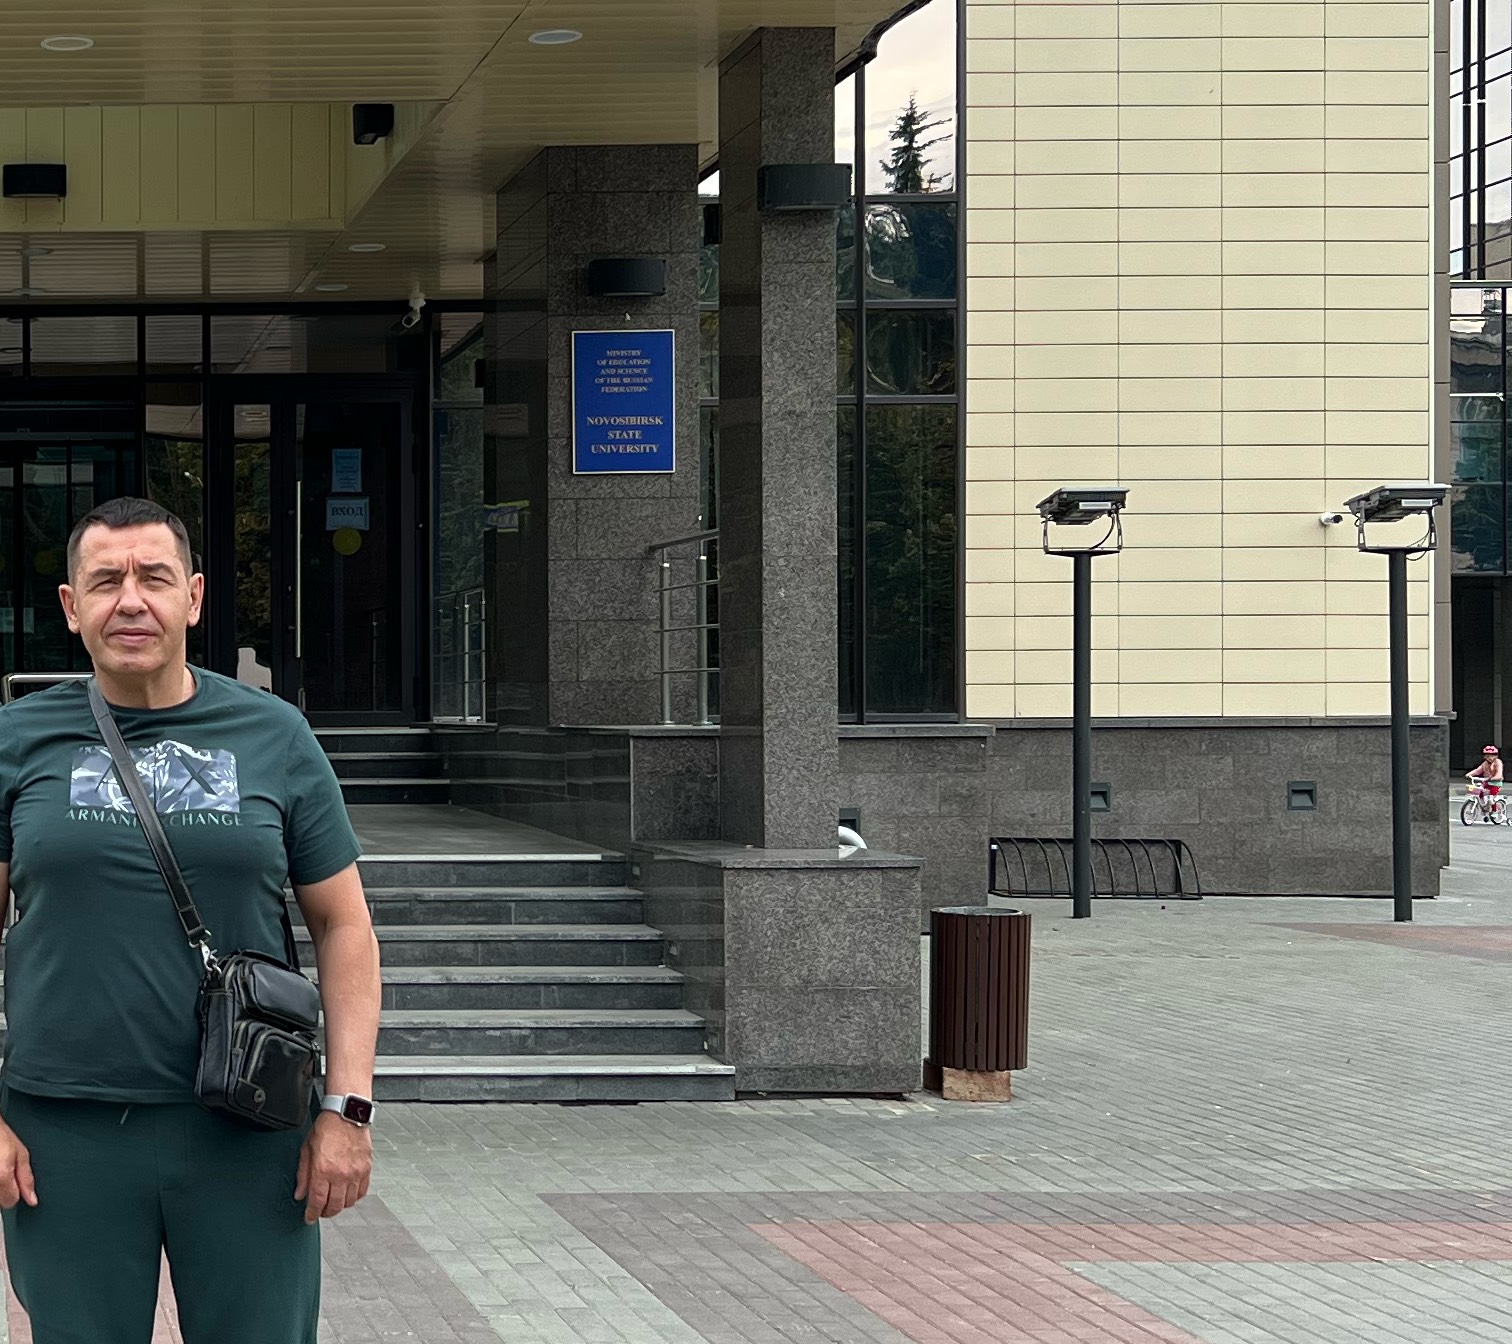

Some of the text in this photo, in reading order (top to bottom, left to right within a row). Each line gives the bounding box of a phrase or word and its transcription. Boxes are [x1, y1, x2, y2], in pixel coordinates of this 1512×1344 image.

[587, 415, 664, 426] NOVOSIBIRSK
[607, 429, 643, 440] STATE
[591, 444, 660, 454] UNIVERSITY
[331, 506, 364, 517] ВХОД
[65, 808, 138, 829] ARMANI
